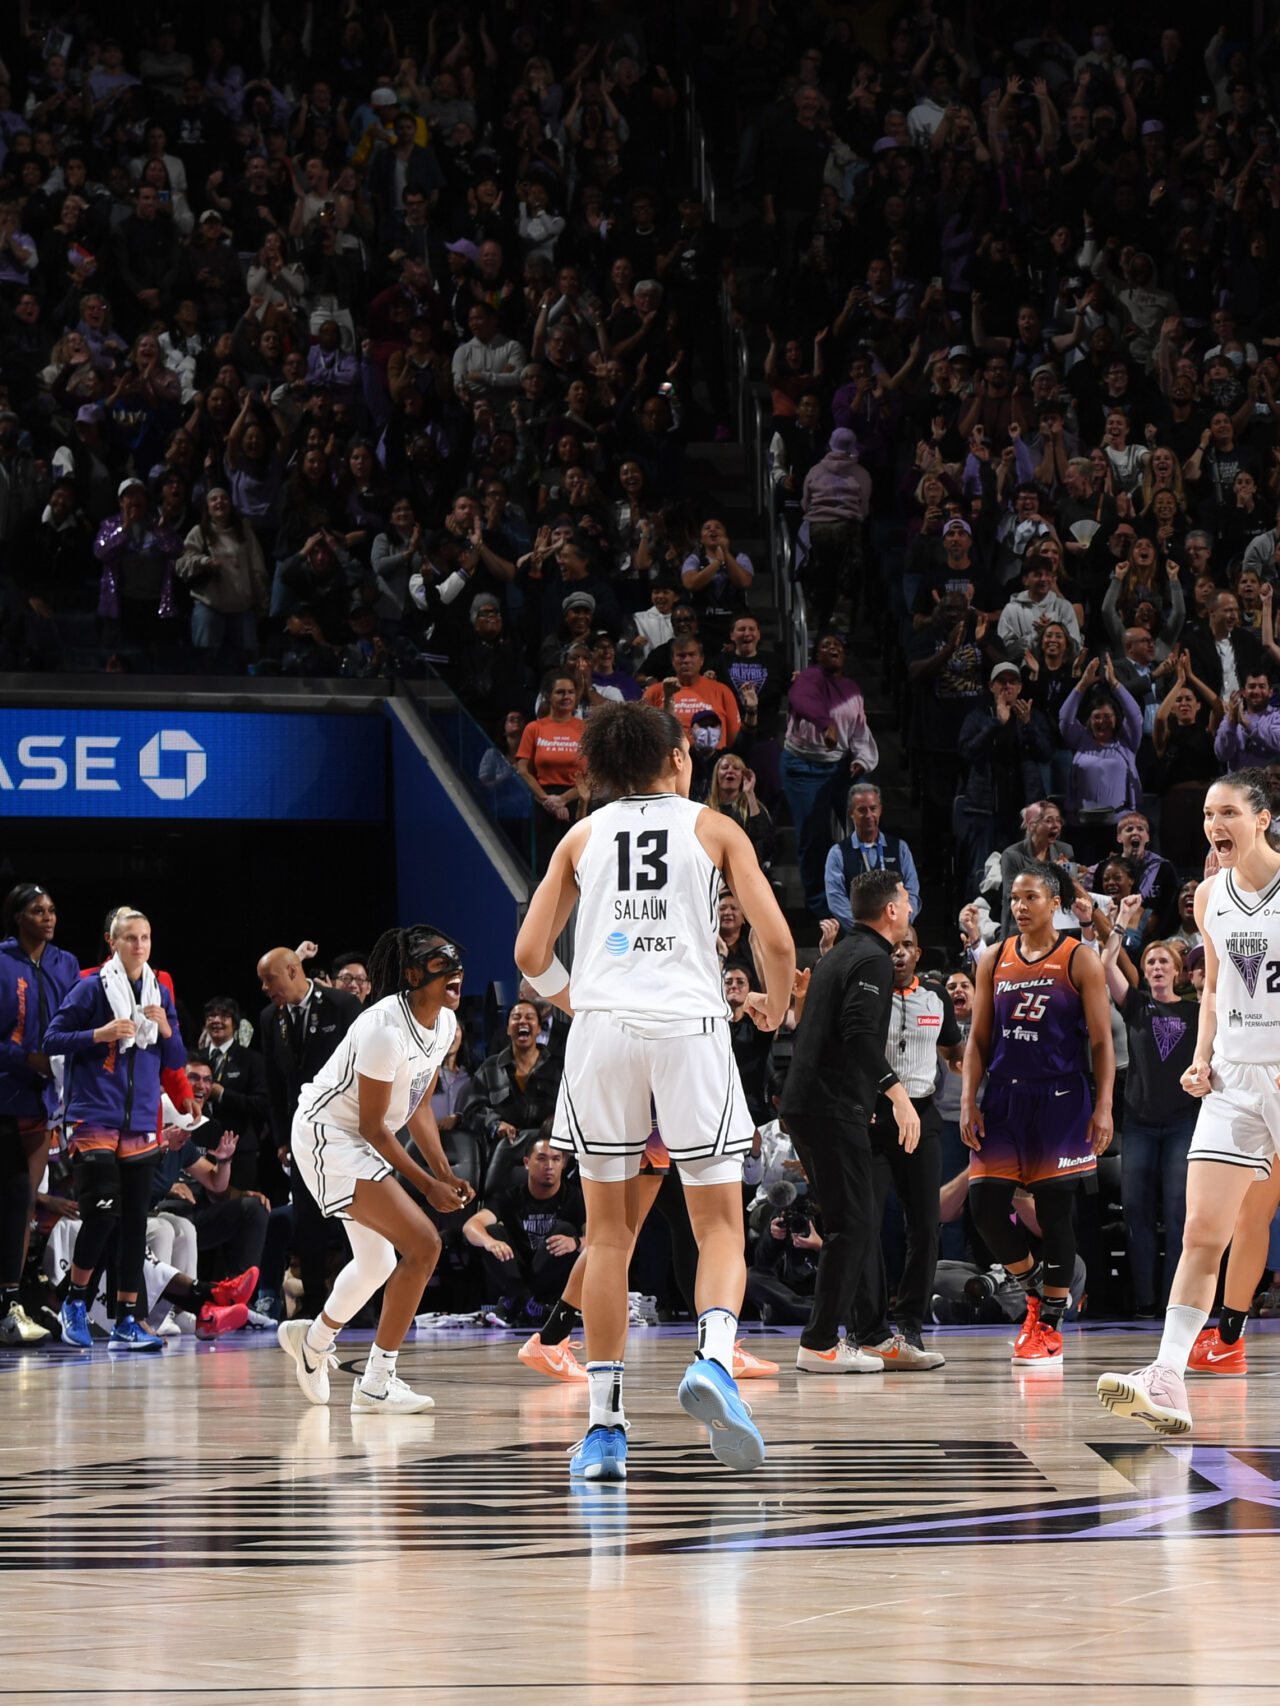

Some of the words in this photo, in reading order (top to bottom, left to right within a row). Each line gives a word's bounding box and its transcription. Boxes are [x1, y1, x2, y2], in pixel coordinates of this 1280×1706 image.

[613, 829, 668, 891] 13
[614, 896, 667, 920] SALAÜN
[633, 936, 676, 952] AT&T
[1226, 938, 1268, 955] VALKYRIES
[996, 978, 1054, 994] Phoenix
[1010, 992, 1050, 1021] 25
